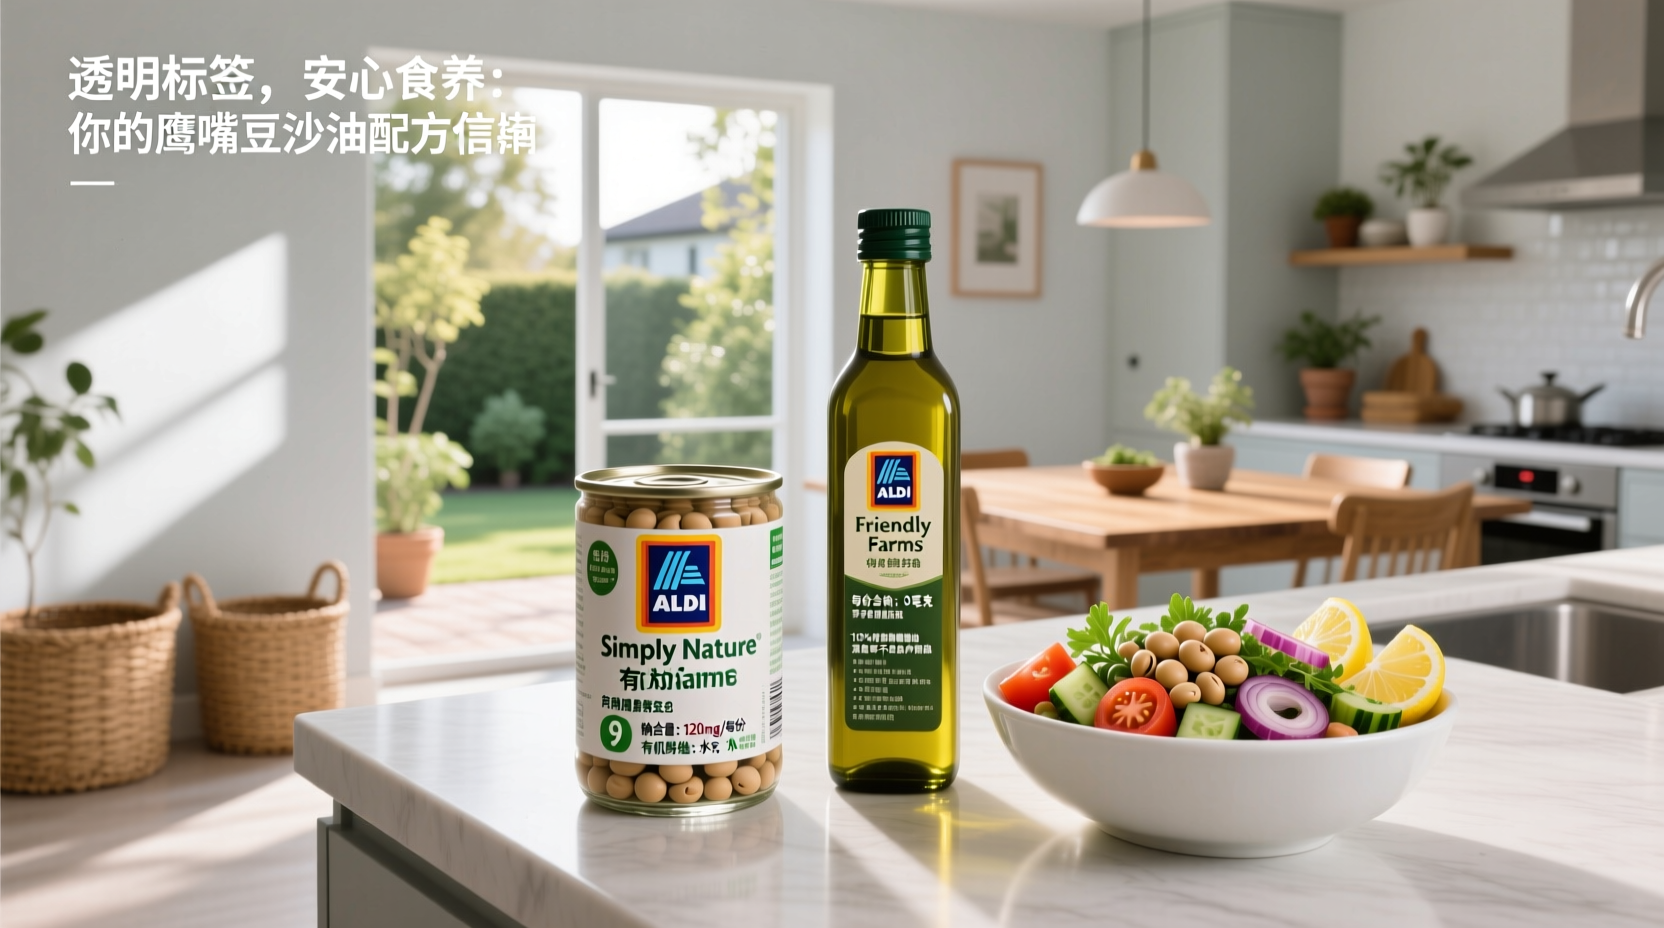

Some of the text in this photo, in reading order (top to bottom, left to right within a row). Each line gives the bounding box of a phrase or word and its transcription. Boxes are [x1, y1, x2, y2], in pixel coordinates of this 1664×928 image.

[877, 486, 911, 499] ALDI
[855, 515, 931, 538] Friendly
[868, 536, 923, 552] Farms
[652, 594, 706, 612] ALDI
[600, 634, 757, 666] Simply Nature
[608, 720, 623, 747] 9
